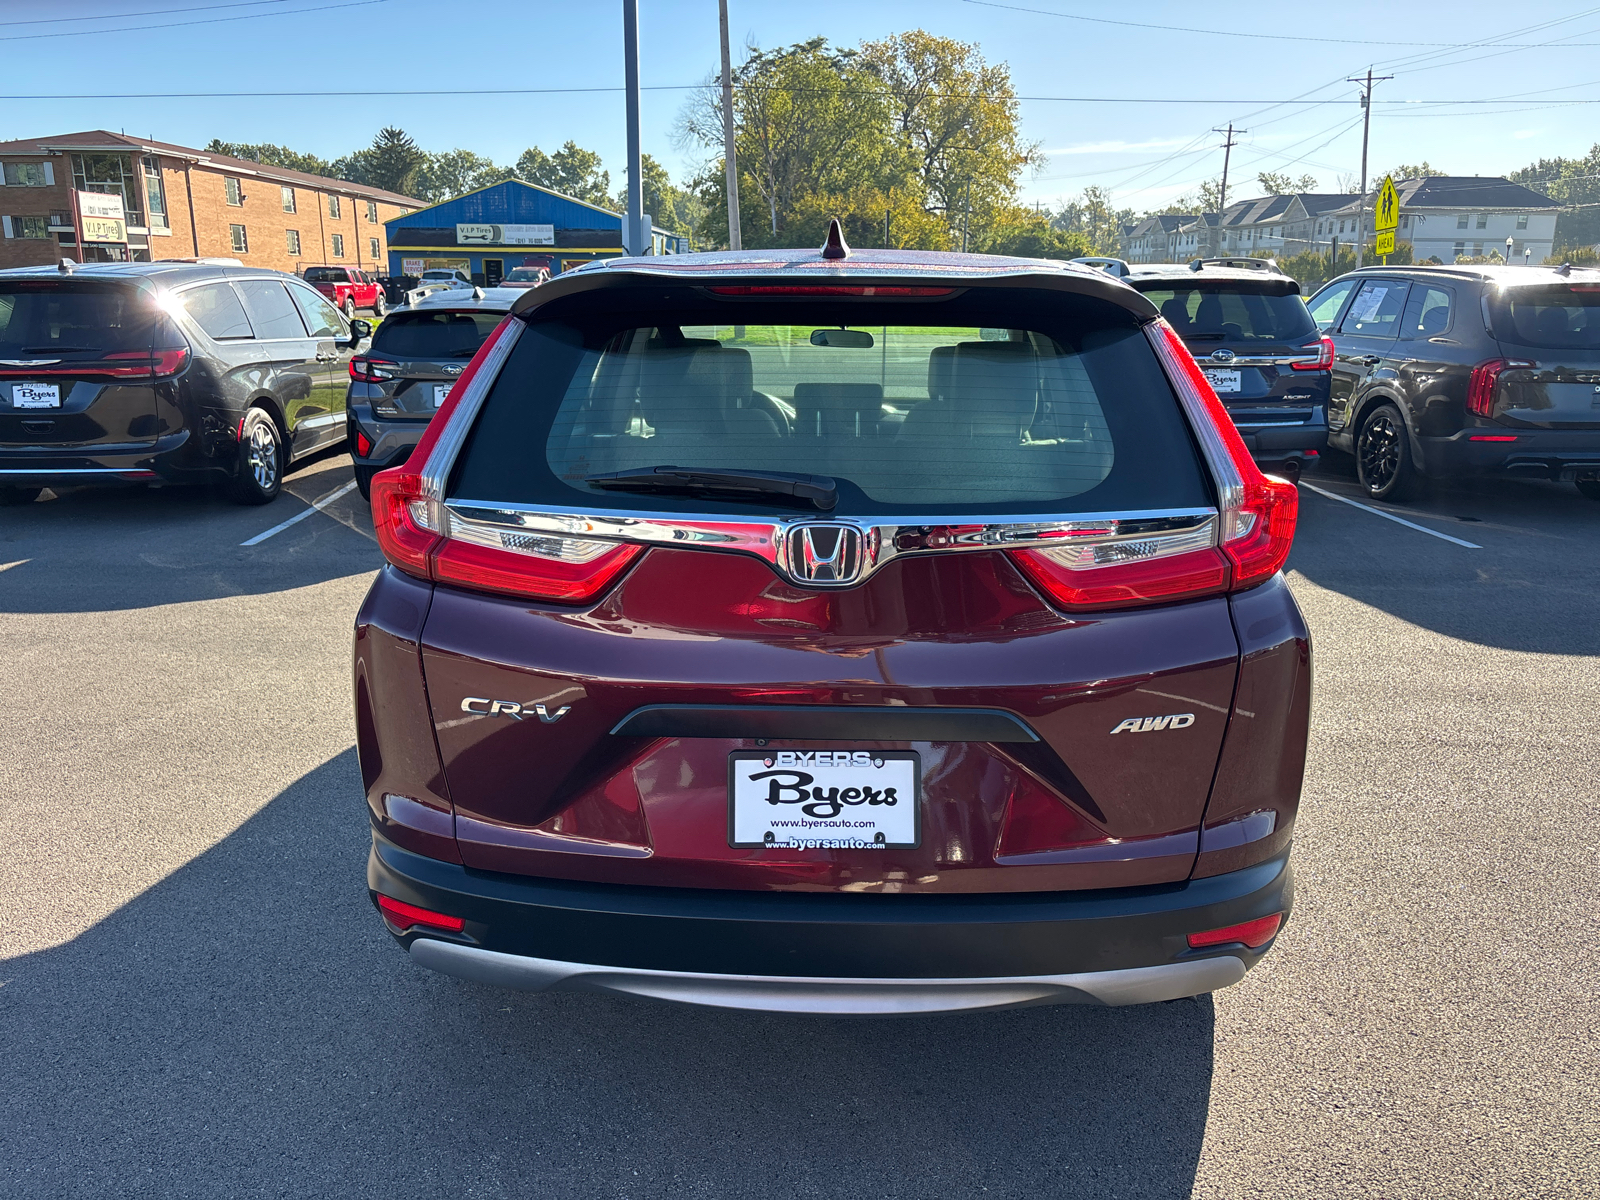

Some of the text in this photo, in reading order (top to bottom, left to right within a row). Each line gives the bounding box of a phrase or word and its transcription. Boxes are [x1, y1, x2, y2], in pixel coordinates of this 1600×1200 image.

[86, 222, 118, 234] V.I.P Tires
[1378, 236, 1393, 250] AHEAD
[1204, 373, 1237, 386] Byers
[17, 388, 56, 400] Byers
[460, 697, 572, 724] CR-V
[1109, 712, 1196, 735] AWD
[776, 751, 872, 768] BYERS
[748, 769, 898, 819] Byers
[770, 817, 876, 830] www.byersauto.com
[765, 836, 886, 851] www.byersauto.com
